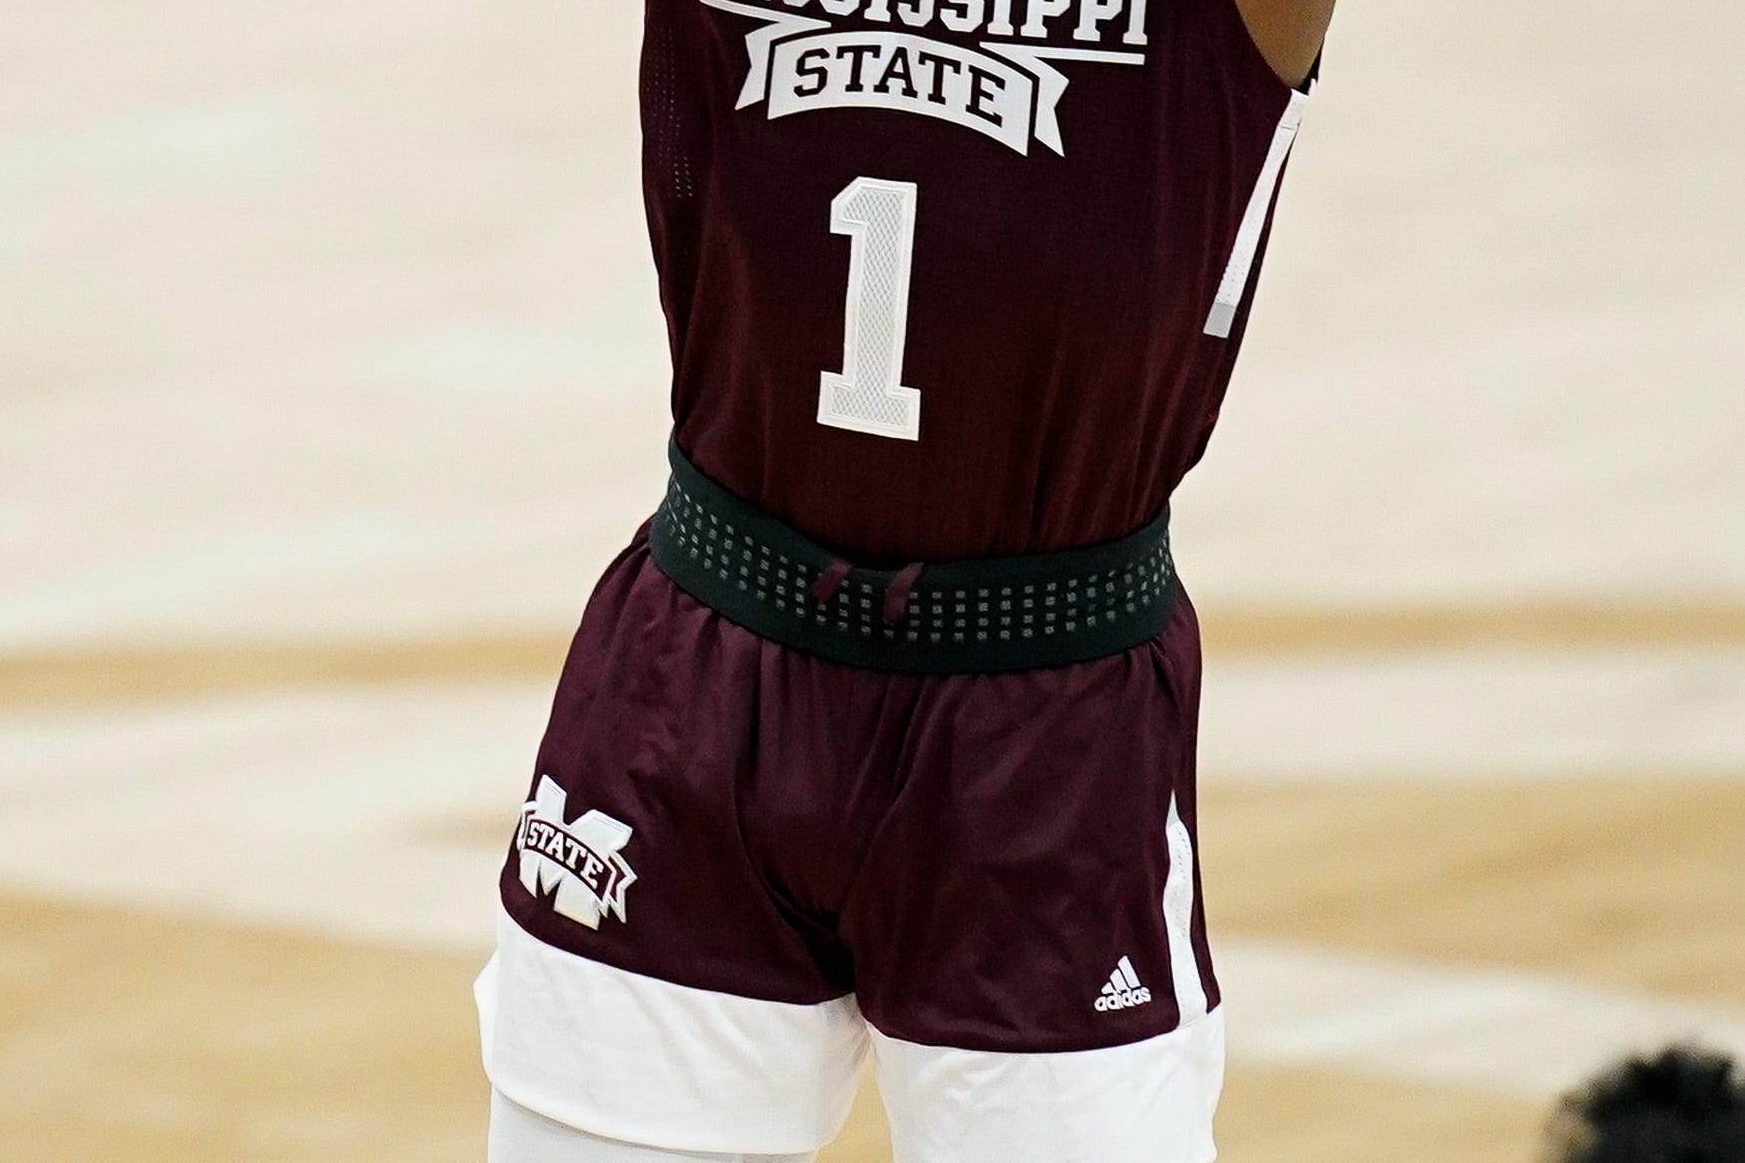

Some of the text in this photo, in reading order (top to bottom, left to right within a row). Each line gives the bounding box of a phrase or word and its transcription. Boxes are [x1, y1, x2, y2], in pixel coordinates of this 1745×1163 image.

[792, 45, 1007, 129] STATE
[815, 175, 922, 442] 1
[526, 820, 606, 891] STATE
[1093, 986, 1152, 1012] adidas
